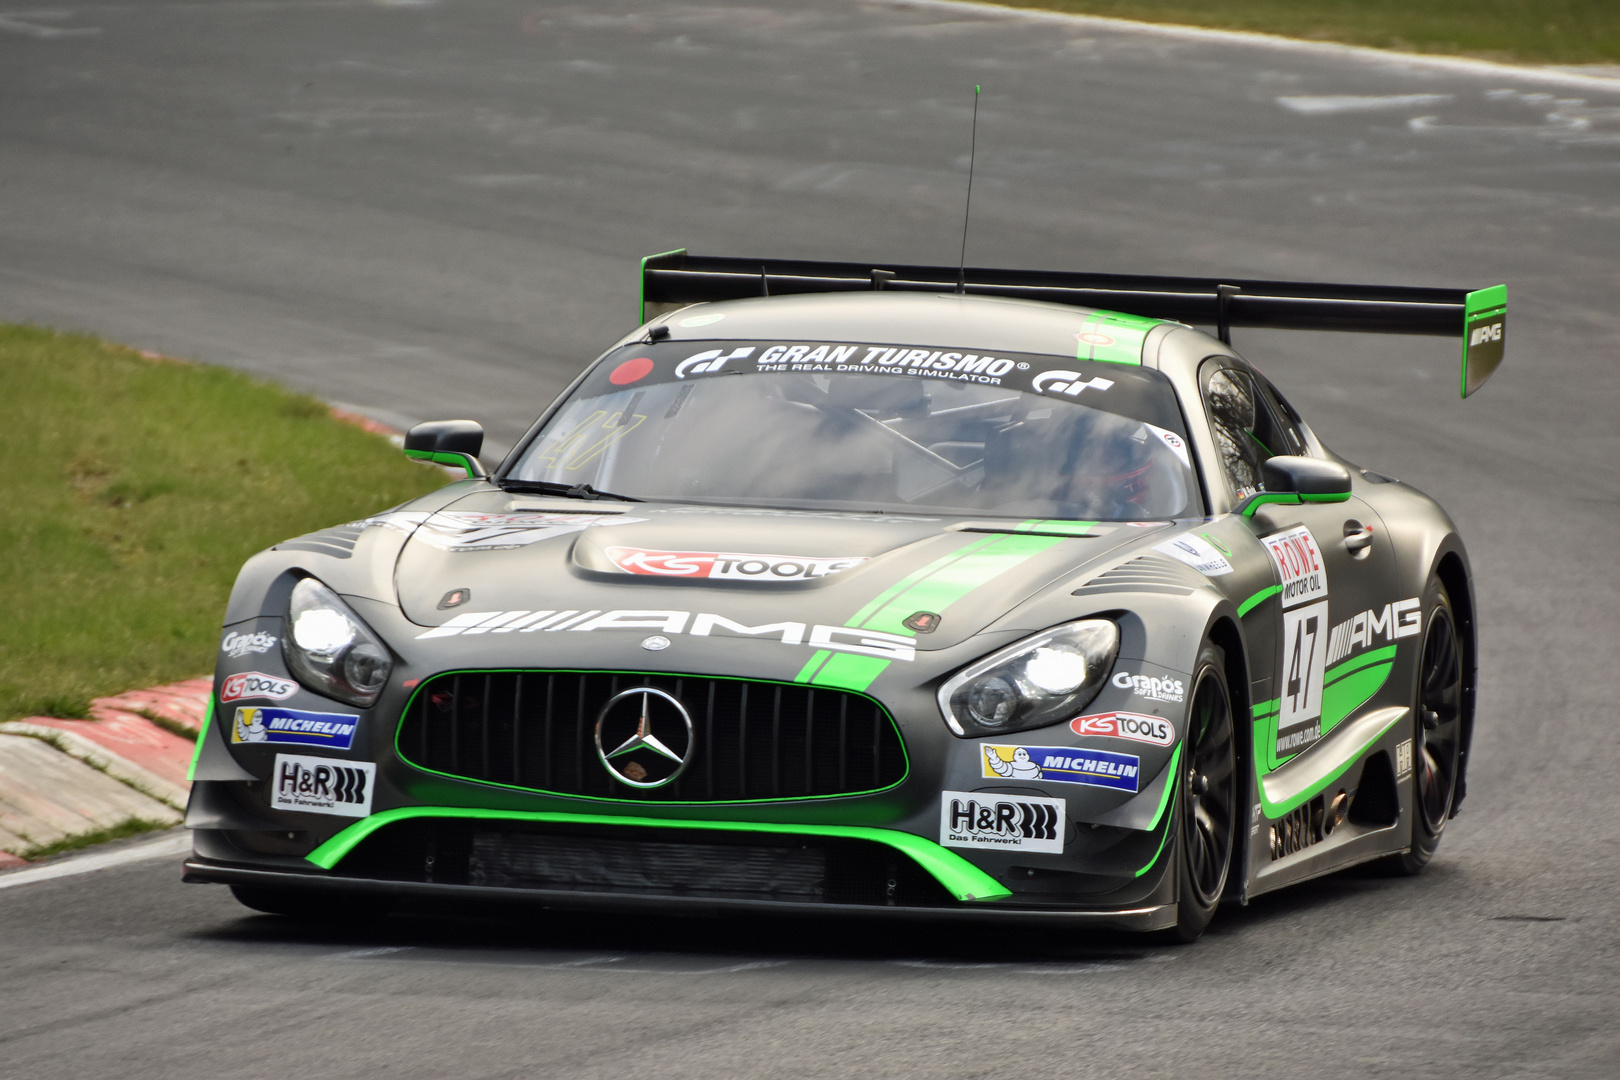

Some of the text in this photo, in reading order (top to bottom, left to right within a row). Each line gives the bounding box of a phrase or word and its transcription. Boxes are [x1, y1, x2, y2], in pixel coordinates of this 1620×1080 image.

[758, 345, 859, 364] GRAN
[756, 364, 788, 372] THE
[836, 364, 903, 375] DRIVING
[907, 367, 1002, 386] SIMULATOR
[621, 552, 715, 575] KS
[1271, 533, 1319, 581] ROWE
[1284, 574, 1321, 600] MOTOR OIL
[582, 609, 917, 661] AMG
[1345, 597, 1422, 655] AMG
[1287, 614, 1319, 714] 47
[244, 677, 291, 695] TOOLS
[1134, 688, 1184, 703] SOFT DRINKS
[269, 717, 354, 736] MICHELIN
[1080, 716, 1167, 740] KS TOOLS
[1276, 720, 1321, 753] www.rowe.com.de
[1042, 755, 1138, 778] MICHELIN
[279, 761, 336, 801] H&R
[277, 796, 293, 805] Das
[949, 799, 1022, 837] H&R
[949, 834, 1022, 845] Das Fahrwerk!
